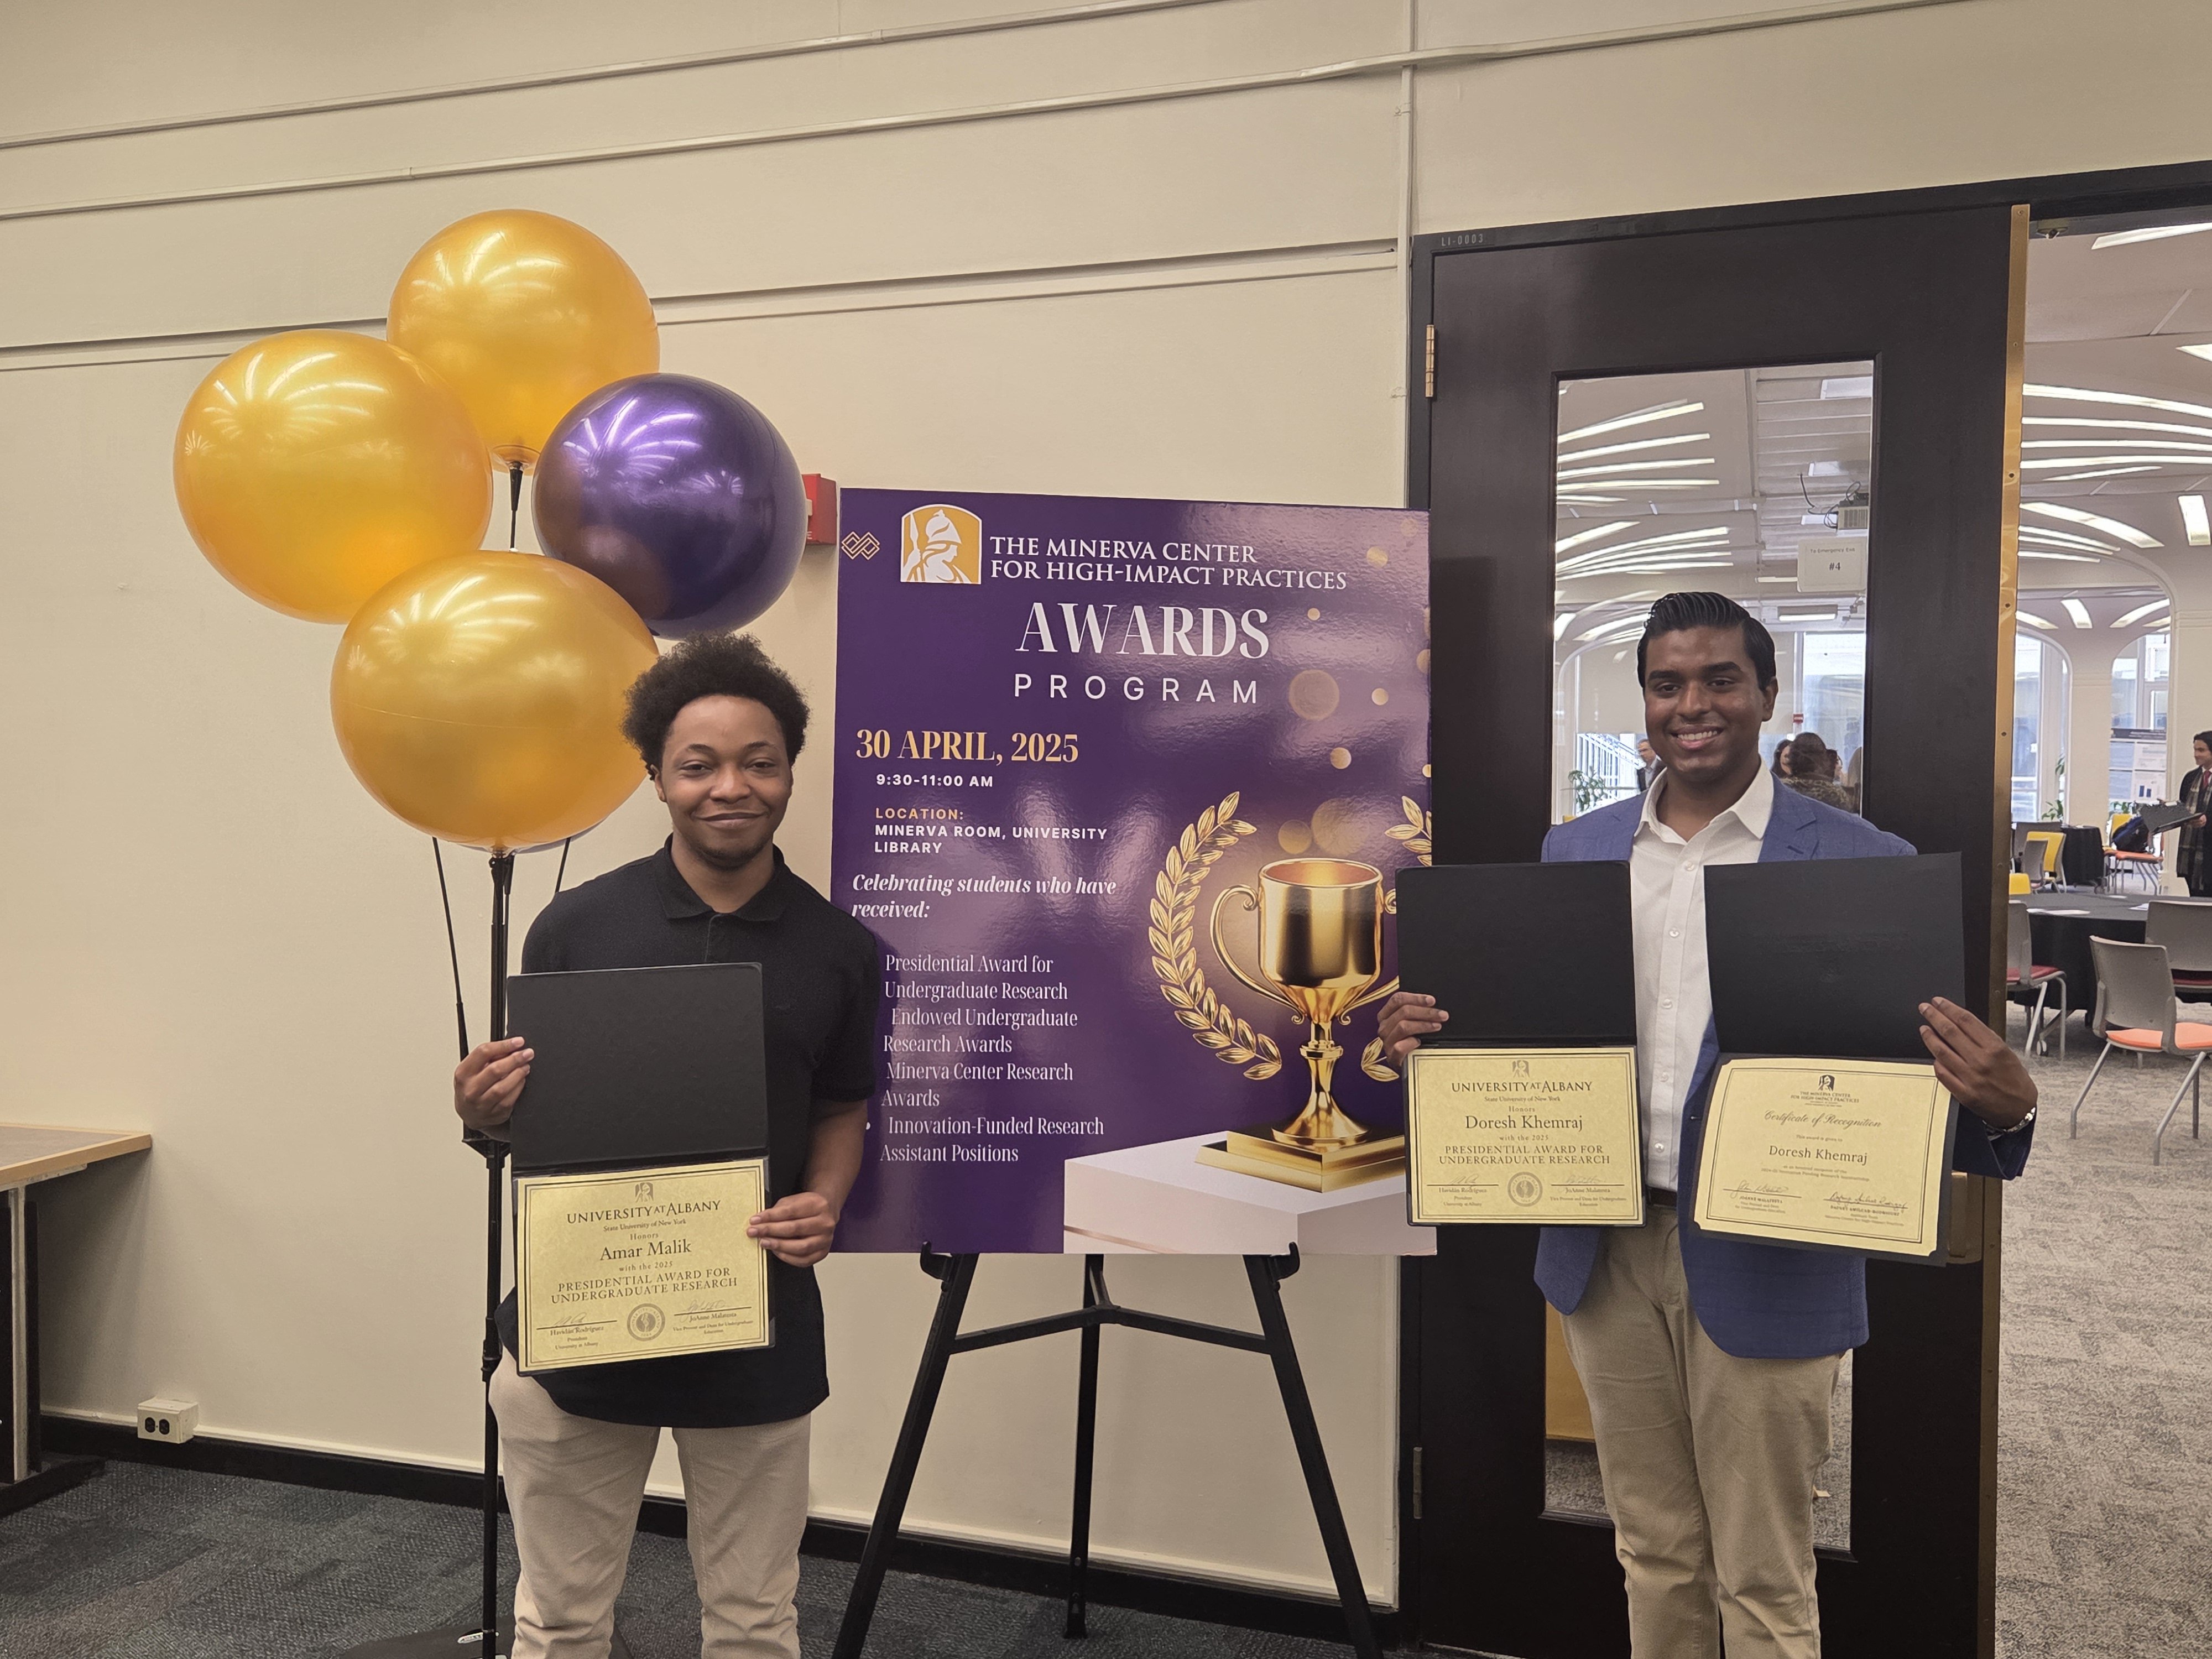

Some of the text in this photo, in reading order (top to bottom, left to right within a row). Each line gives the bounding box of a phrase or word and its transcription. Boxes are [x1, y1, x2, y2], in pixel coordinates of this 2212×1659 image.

[1442, 234, 1483, 247] LI-0003
[990, 536, 1258, 563] THE MINERVA CENTER
[990, 560, 1347, 589] FOR HIGH-IMPACT PRACTICES
[1829, 562, 1840, 571] #4
[1015, 602, 1269, 659] AWARDS
[1014, 674, 1256, 704] PROGRAM
[856, 729, 1078, 766] 30 APRIL, 2025
[876, 774, 993, 787] 9:30-11:00 AM
[875, 808, 964, 820] LOCATION:
[875, 825, 1107, 840] MINERVA ROOM, UNIVERSITY
[874, 842, 942, 853] LIBRARY
[853, 874, 1117, 896] Celebrating students who have
[852, 901, 930, 918] received:
[885, 954, 1053, 973] Presidential Award for
[885, 981, 1068, 1003] Undergraduate Research
[891, 1008, 1078, 1030] Endowed Undergraduate
[884, 1035, 1012, 1052] Research Awards
[886, 1062, 1073, 1081] Minerva Center Research
[1452, 1082, 1528, 1092] UNIVERSITY
[1542, 1081, 1592, 1093] ALBANY
[880, 1089, 940, 1107] Awards
[889, 1117, 1104, 1135] Innovation-Funded Research
[1465, 1115, 1583, 1132] Doresh Khemraj
[1765, 1110, 1881, 1130] Certificate of Recognition
[879, 1144, 1019, 1162] Assistant Positions
[1534, 1145, 1576, 1154] AWARD
[1580, 1145, 1603, 1154] FOR
[1769, 1145, 1867, 1166] Doresh Khemraj
[1439, 1156, 1610, 1164] UNDERGRADUATE RESEARCH
[567, 1200, 721, 1224] UNIVERSITY AT ALBANY
[599, 1239, 691, 1261] Amar Malik
[619, 1264, 636, 1272] with
[558, 1267, 731, 1292] PRESIDENTIAL AWARD FOR
[552, 1277, 737, 1304] UNDERGRADUATE RESEARCH
